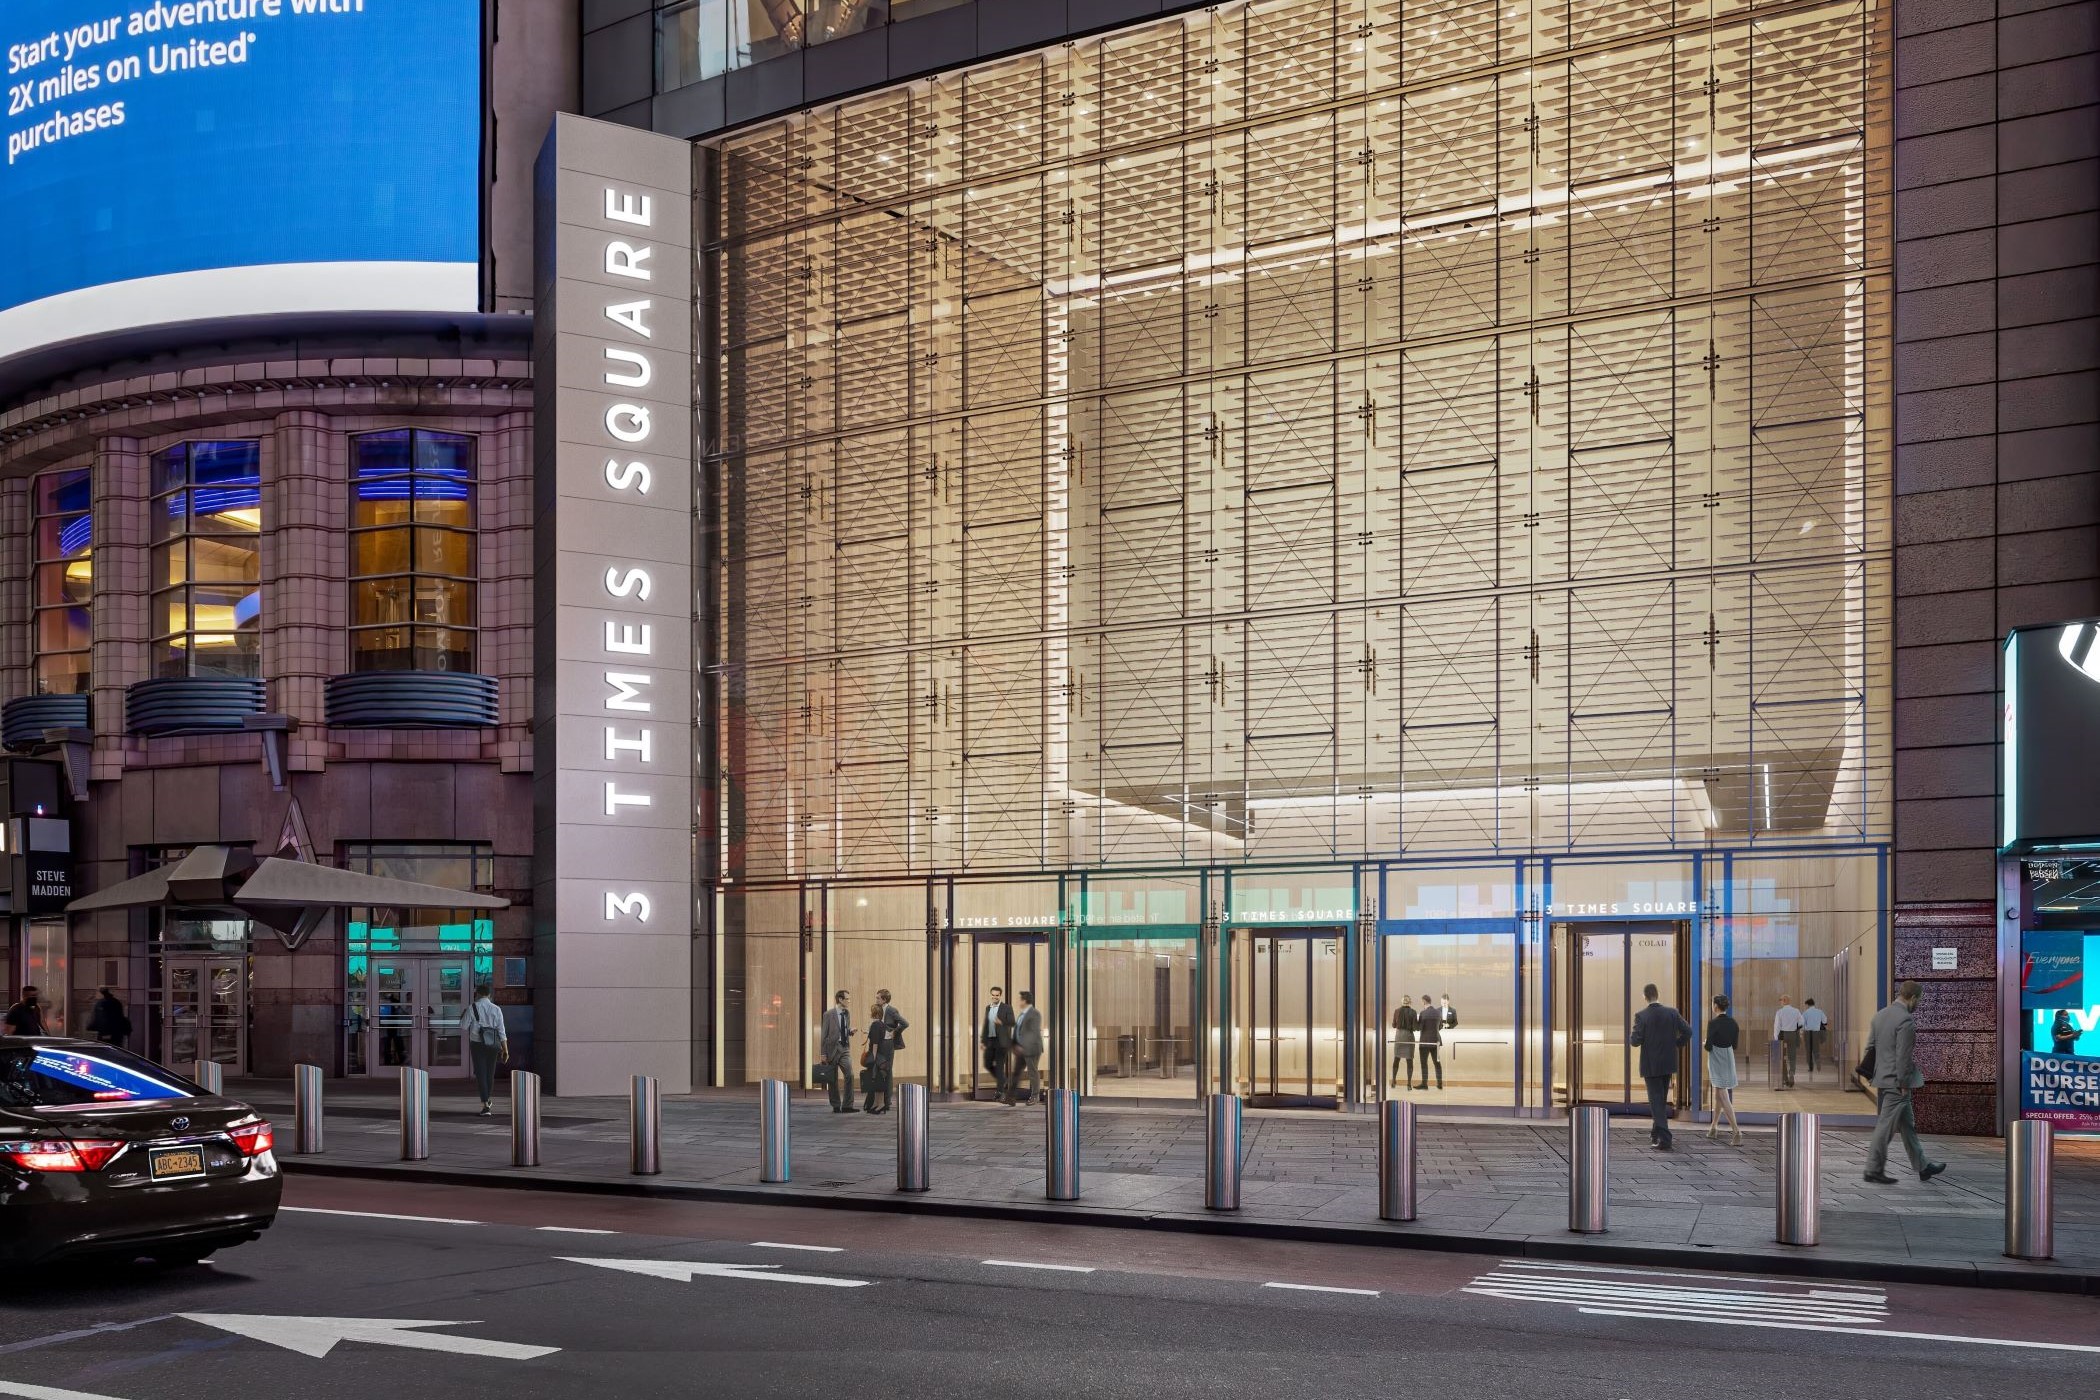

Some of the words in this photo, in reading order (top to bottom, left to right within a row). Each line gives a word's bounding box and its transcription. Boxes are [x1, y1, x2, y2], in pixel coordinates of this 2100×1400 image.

[8, 31, 59, 74] Start
[64, 16, 122, 61] your
[127, 0, 281, 36] adventure
[8, 80, 34, 116] 2X
[39, 64, 100, 104] miles
[106, 55, 140, 83] on
[8, 101, 126, 165] purchases
[606, 188, 651, 494] SQUARE
[606, 567, 651, 815] TIMES
[36, 870, 66, 882] STEVE
[31, 884, 71, 896] MADDEN
[606, 892, 651, 922] 3
[1222, 911, 1230, 921] 3
[1241, 910, 1286, 921] TIMES
[1297, 909, 1353, 920] SQUARE
[1545, 904, 1553, 915] 3
[1567, 903, 1619, 914] TIMES
[1633, 901, 1698, 913] SQUARE
[943, 918, 949, 928] 3
[959, 917, 998, 927] TIMES
[1007, 915, 1056, 926] SQUARE
[2030, 1057, 2100, 1074] DOCTO
[2030, 1089, 2100, 1107] TEACH
[2079, 1113, 2093, 1121] 25%
